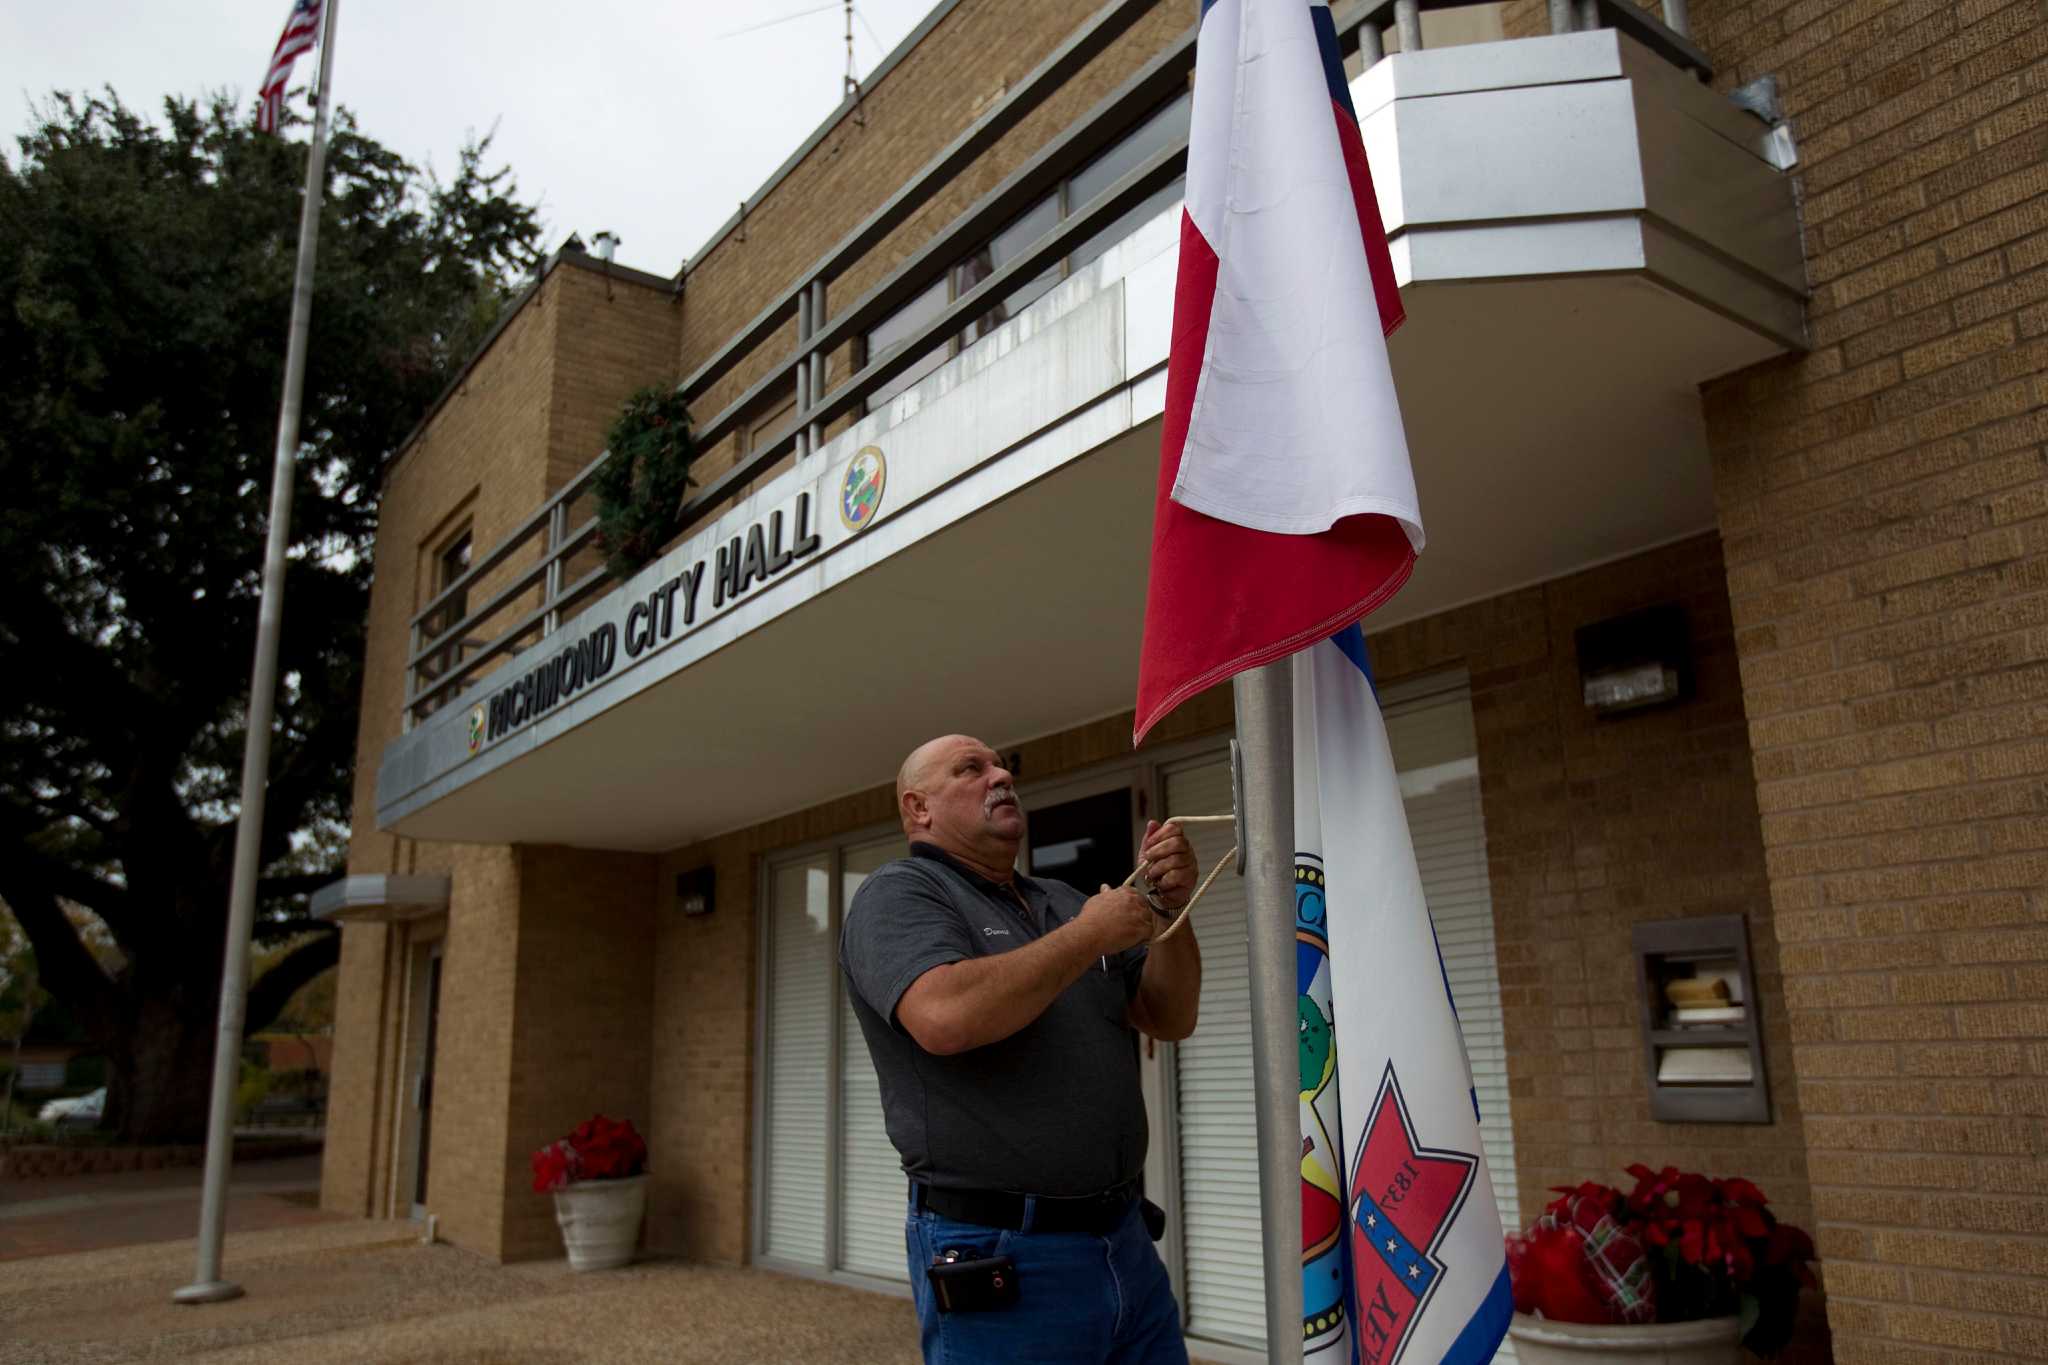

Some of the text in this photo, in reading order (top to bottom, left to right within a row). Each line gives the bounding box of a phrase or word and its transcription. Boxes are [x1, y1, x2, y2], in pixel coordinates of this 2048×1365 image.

[487, 492, 821, 741] RICHMOND CITY HALL
